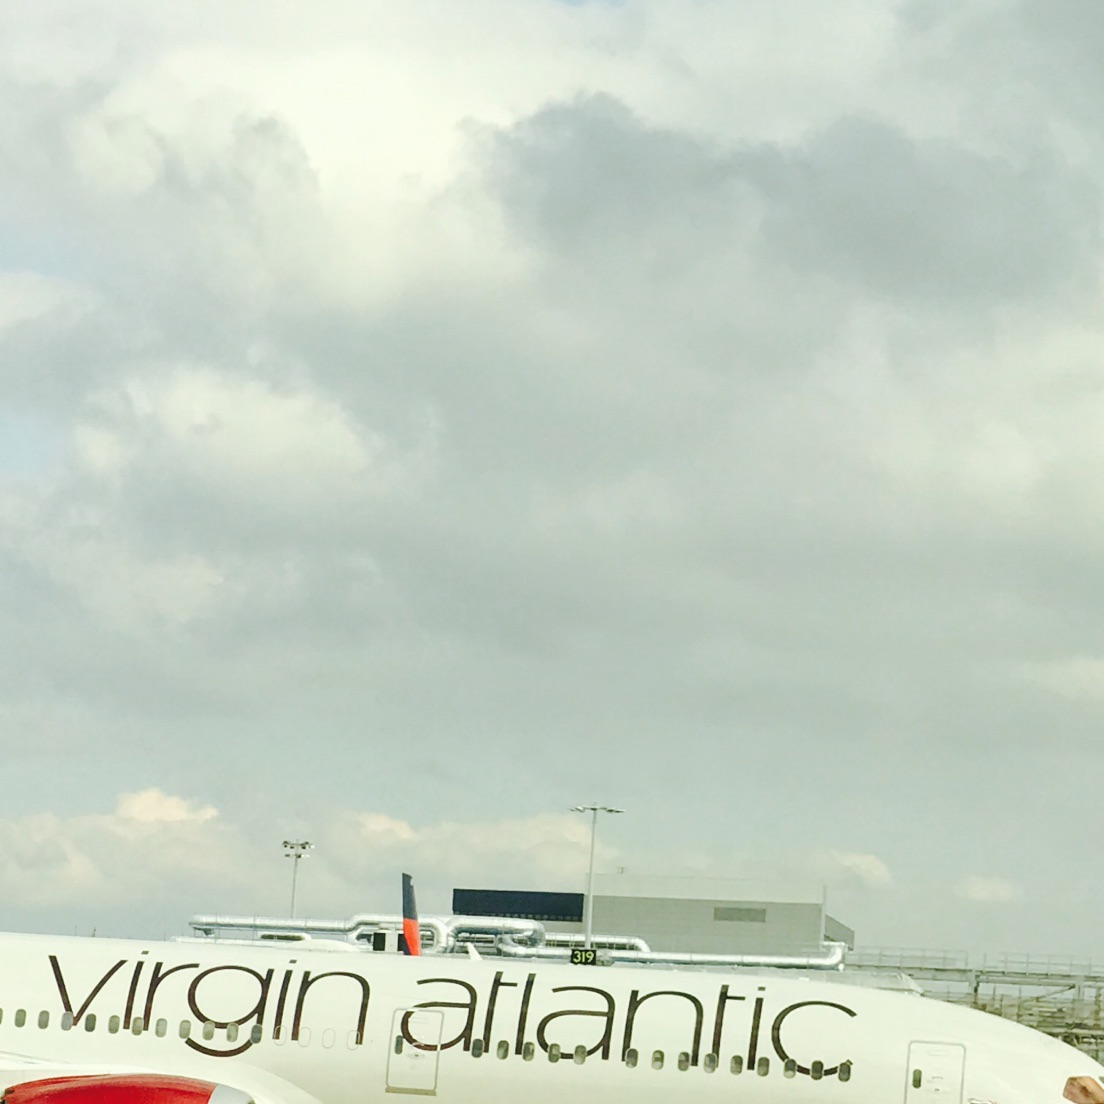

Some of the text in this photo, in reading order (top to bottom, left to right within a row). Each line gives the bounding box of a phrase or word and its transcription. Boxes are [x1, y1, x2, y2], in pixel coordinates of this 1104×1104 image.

[573, 950, 594, 962] 319
[48, 950, 858, 1077] virgin atlantic
